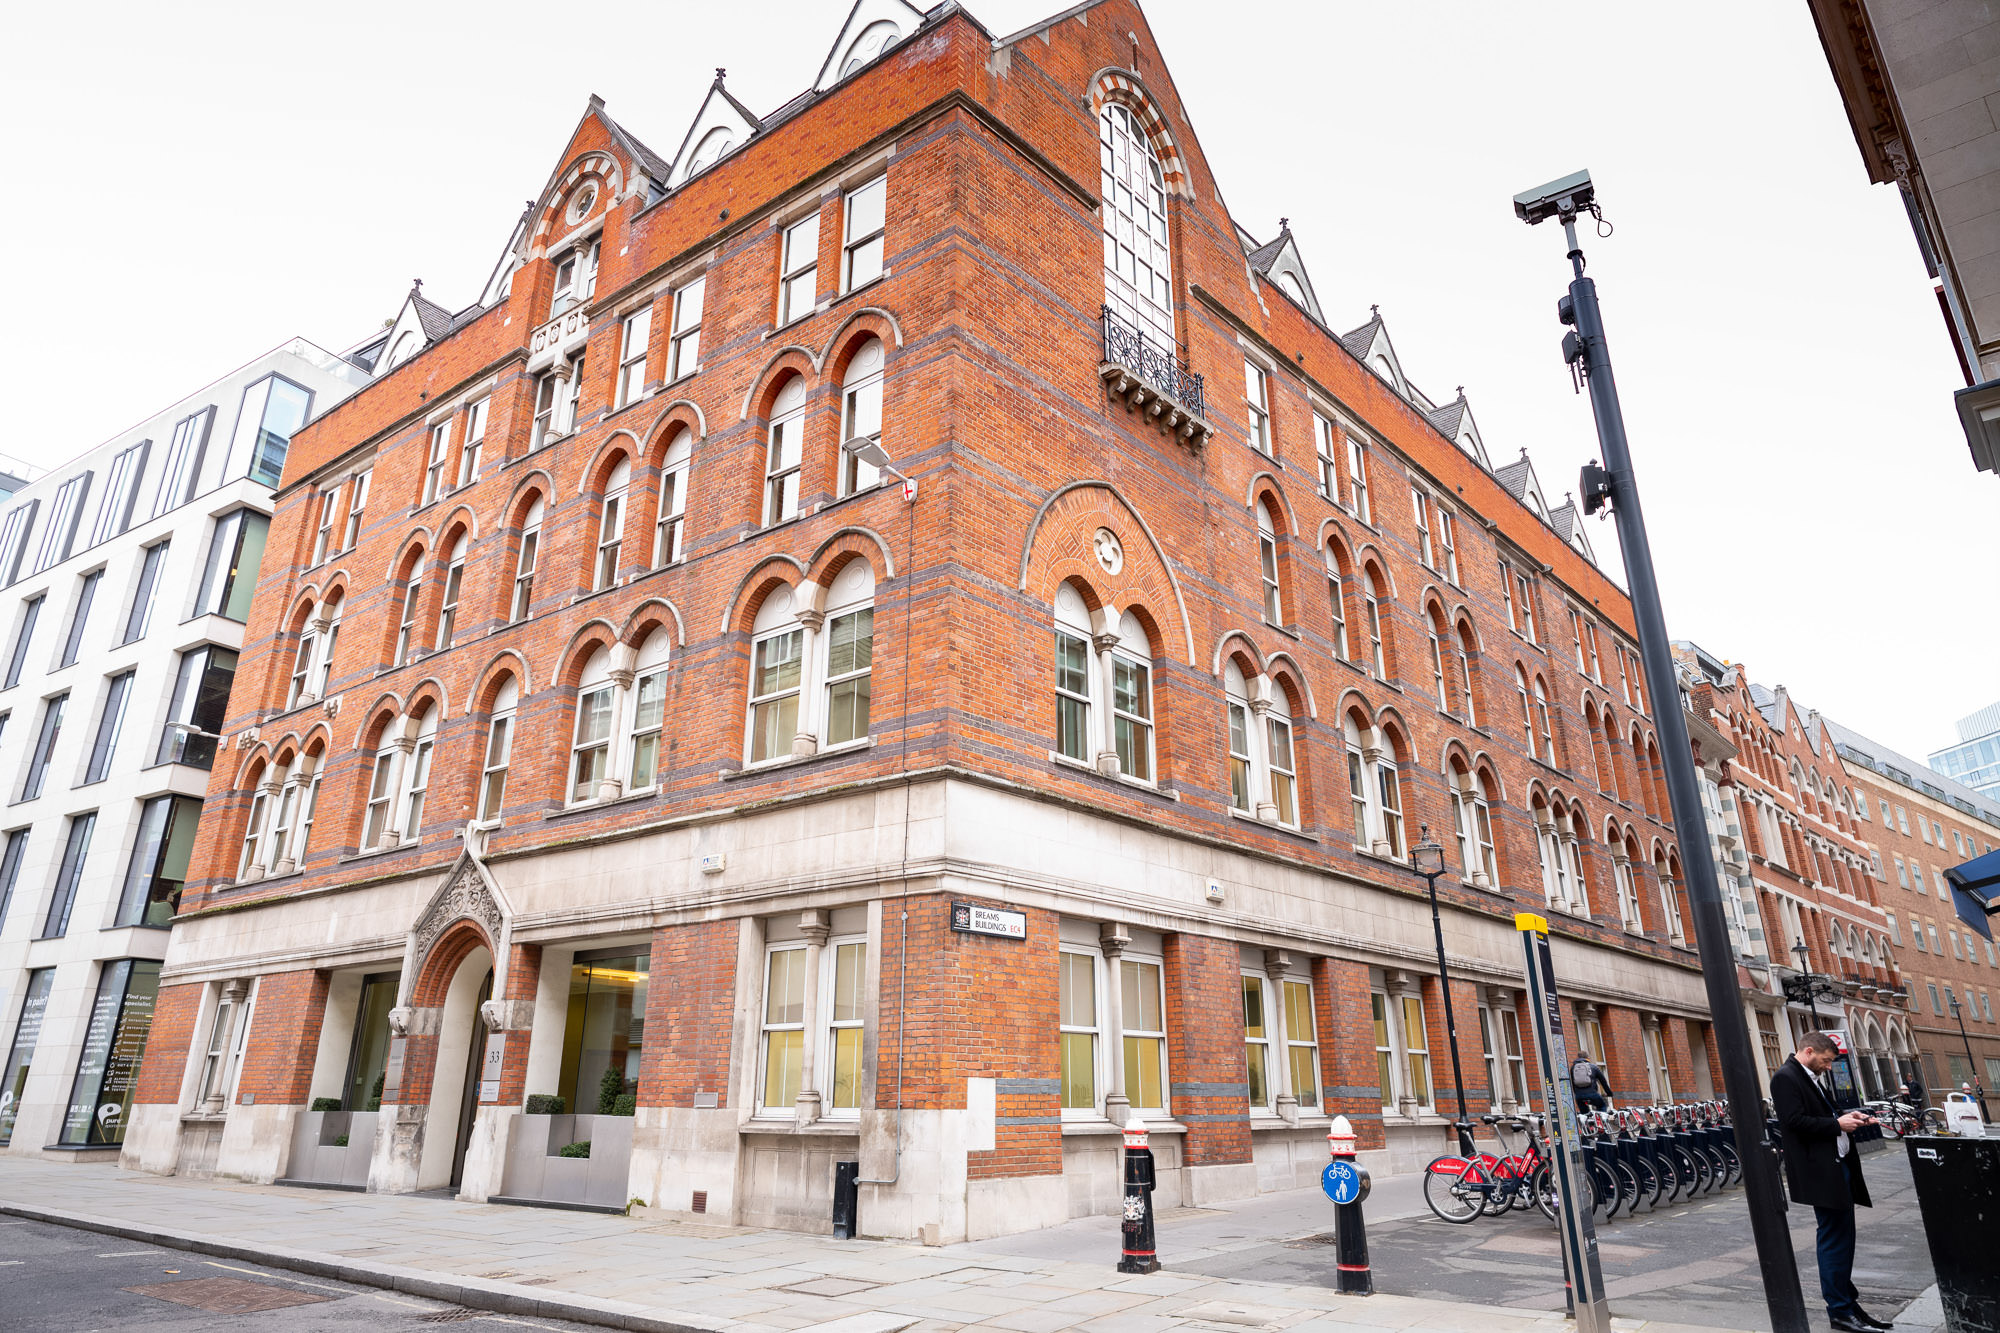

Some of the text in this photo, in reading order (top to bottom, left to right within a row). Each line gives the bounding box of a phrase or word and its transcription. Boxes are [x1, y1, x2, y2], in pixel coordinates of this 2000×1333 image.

[975, 910, 1000, 922] BREAMS
[975, 920, 1021, 934] BUILDINGS EC4
[489, 1051, 500, 1063] 33
